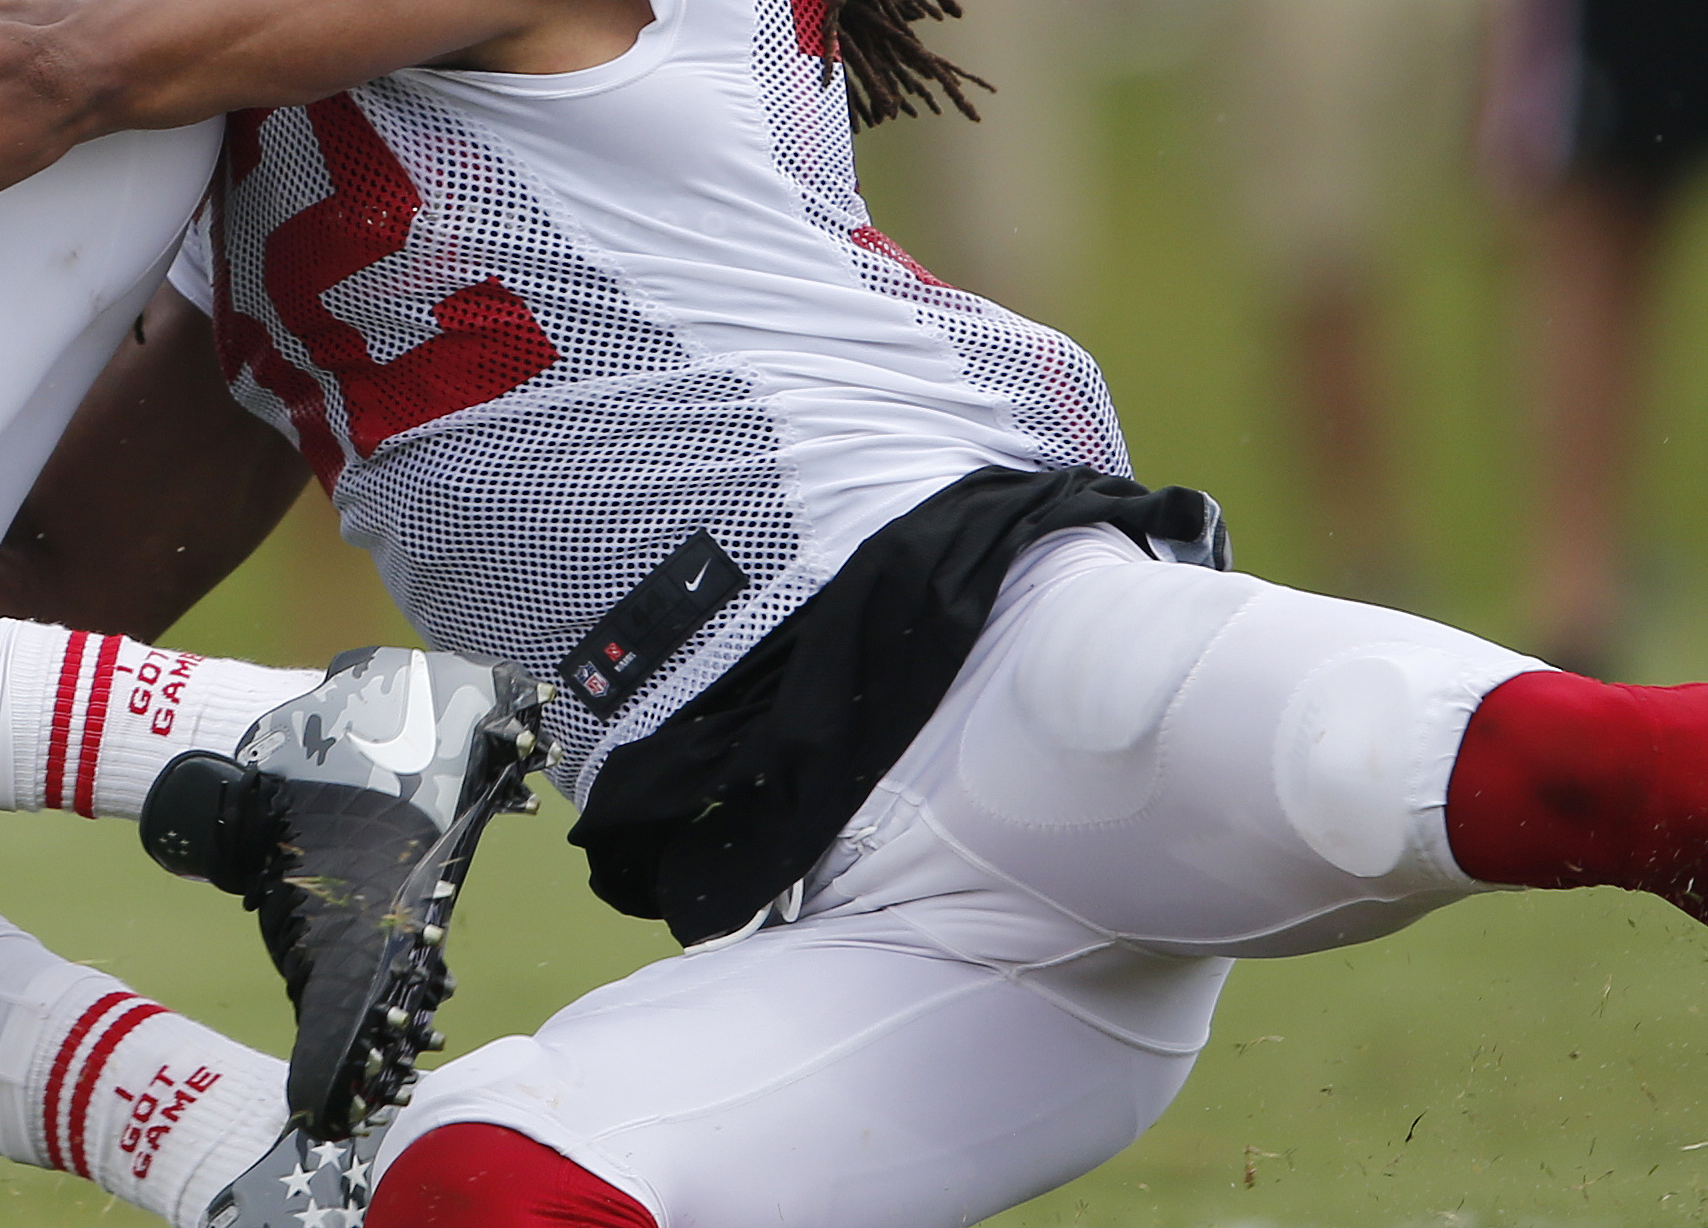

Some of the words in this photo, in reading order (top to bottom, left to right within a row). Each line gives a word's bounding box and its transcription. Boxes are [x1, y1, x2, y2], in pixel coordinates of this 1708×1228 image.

[115, 663, 133, 673] I
[128, 650, 170, 715] GOT
[151, 652, 206, 737] GAME
[114, 1085, 134, 1102] I
[120, 1064, 174, 1153] GOT
[132, 1065, 223, 1180] GAME
